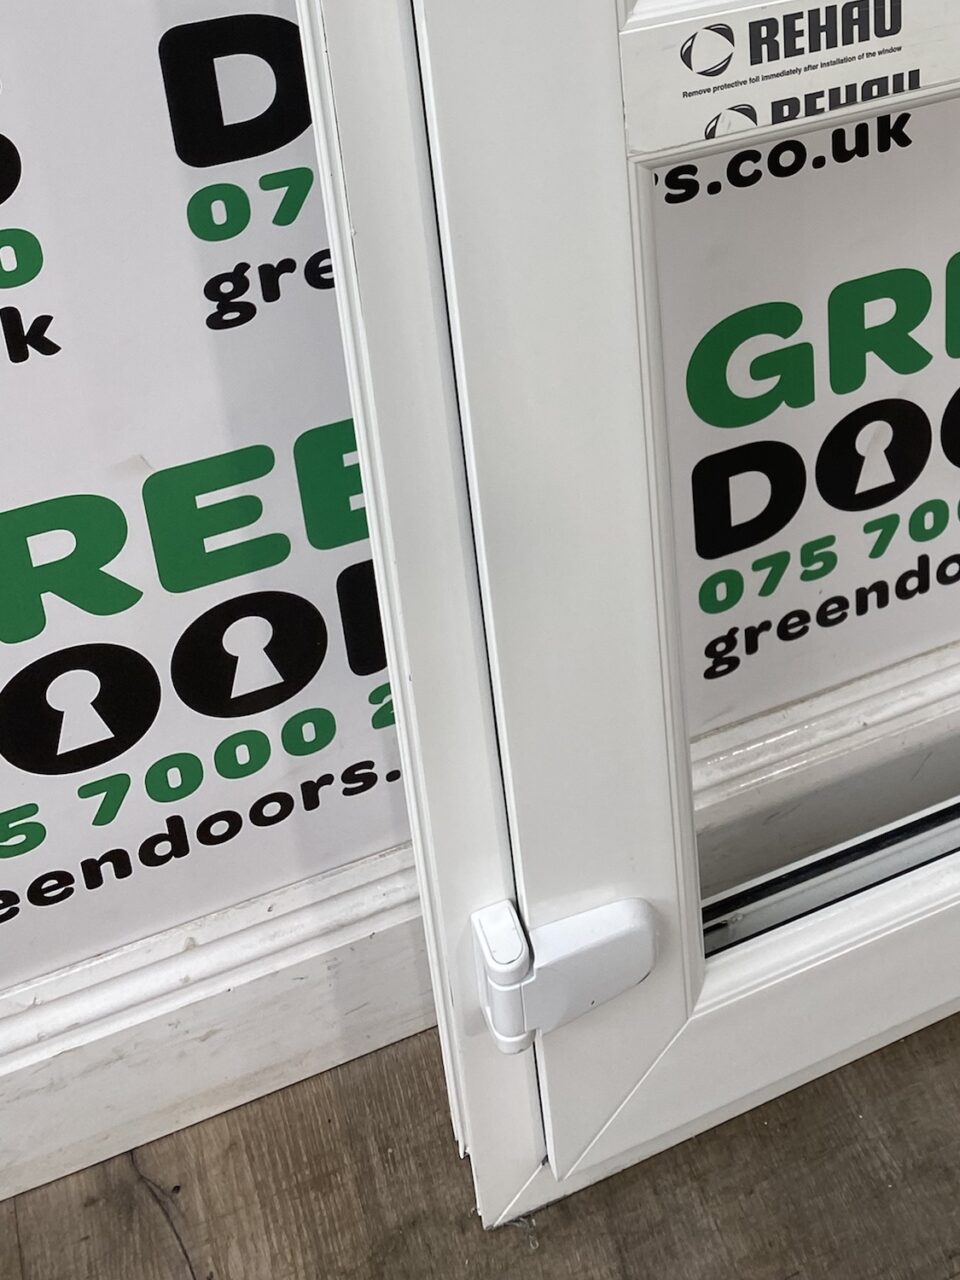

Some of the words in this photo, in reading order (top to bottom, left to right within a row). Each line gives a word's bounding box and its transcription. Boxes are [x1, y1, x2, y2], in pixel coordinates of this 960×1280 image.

[682, 87, 711, 98] Remove
[712, 79, 747, 93] protective
[749, 74, 760, 84] foil
[761, 66, 802, 81] immediately
[803, 62, 819, 73] after
[820, 54, 856, 68] installation
[857, 52, 865, 60] of
[865, 50, 876, 59] the
[877, 46, 902, 57] window
[654, 112, 913, 205] s.co.uk
[186, 166, 315, 243] 07
[0, 306, 62, 364] k
[698, 535, 838, 614] 075
[77, 707, 337, 827] 7000
